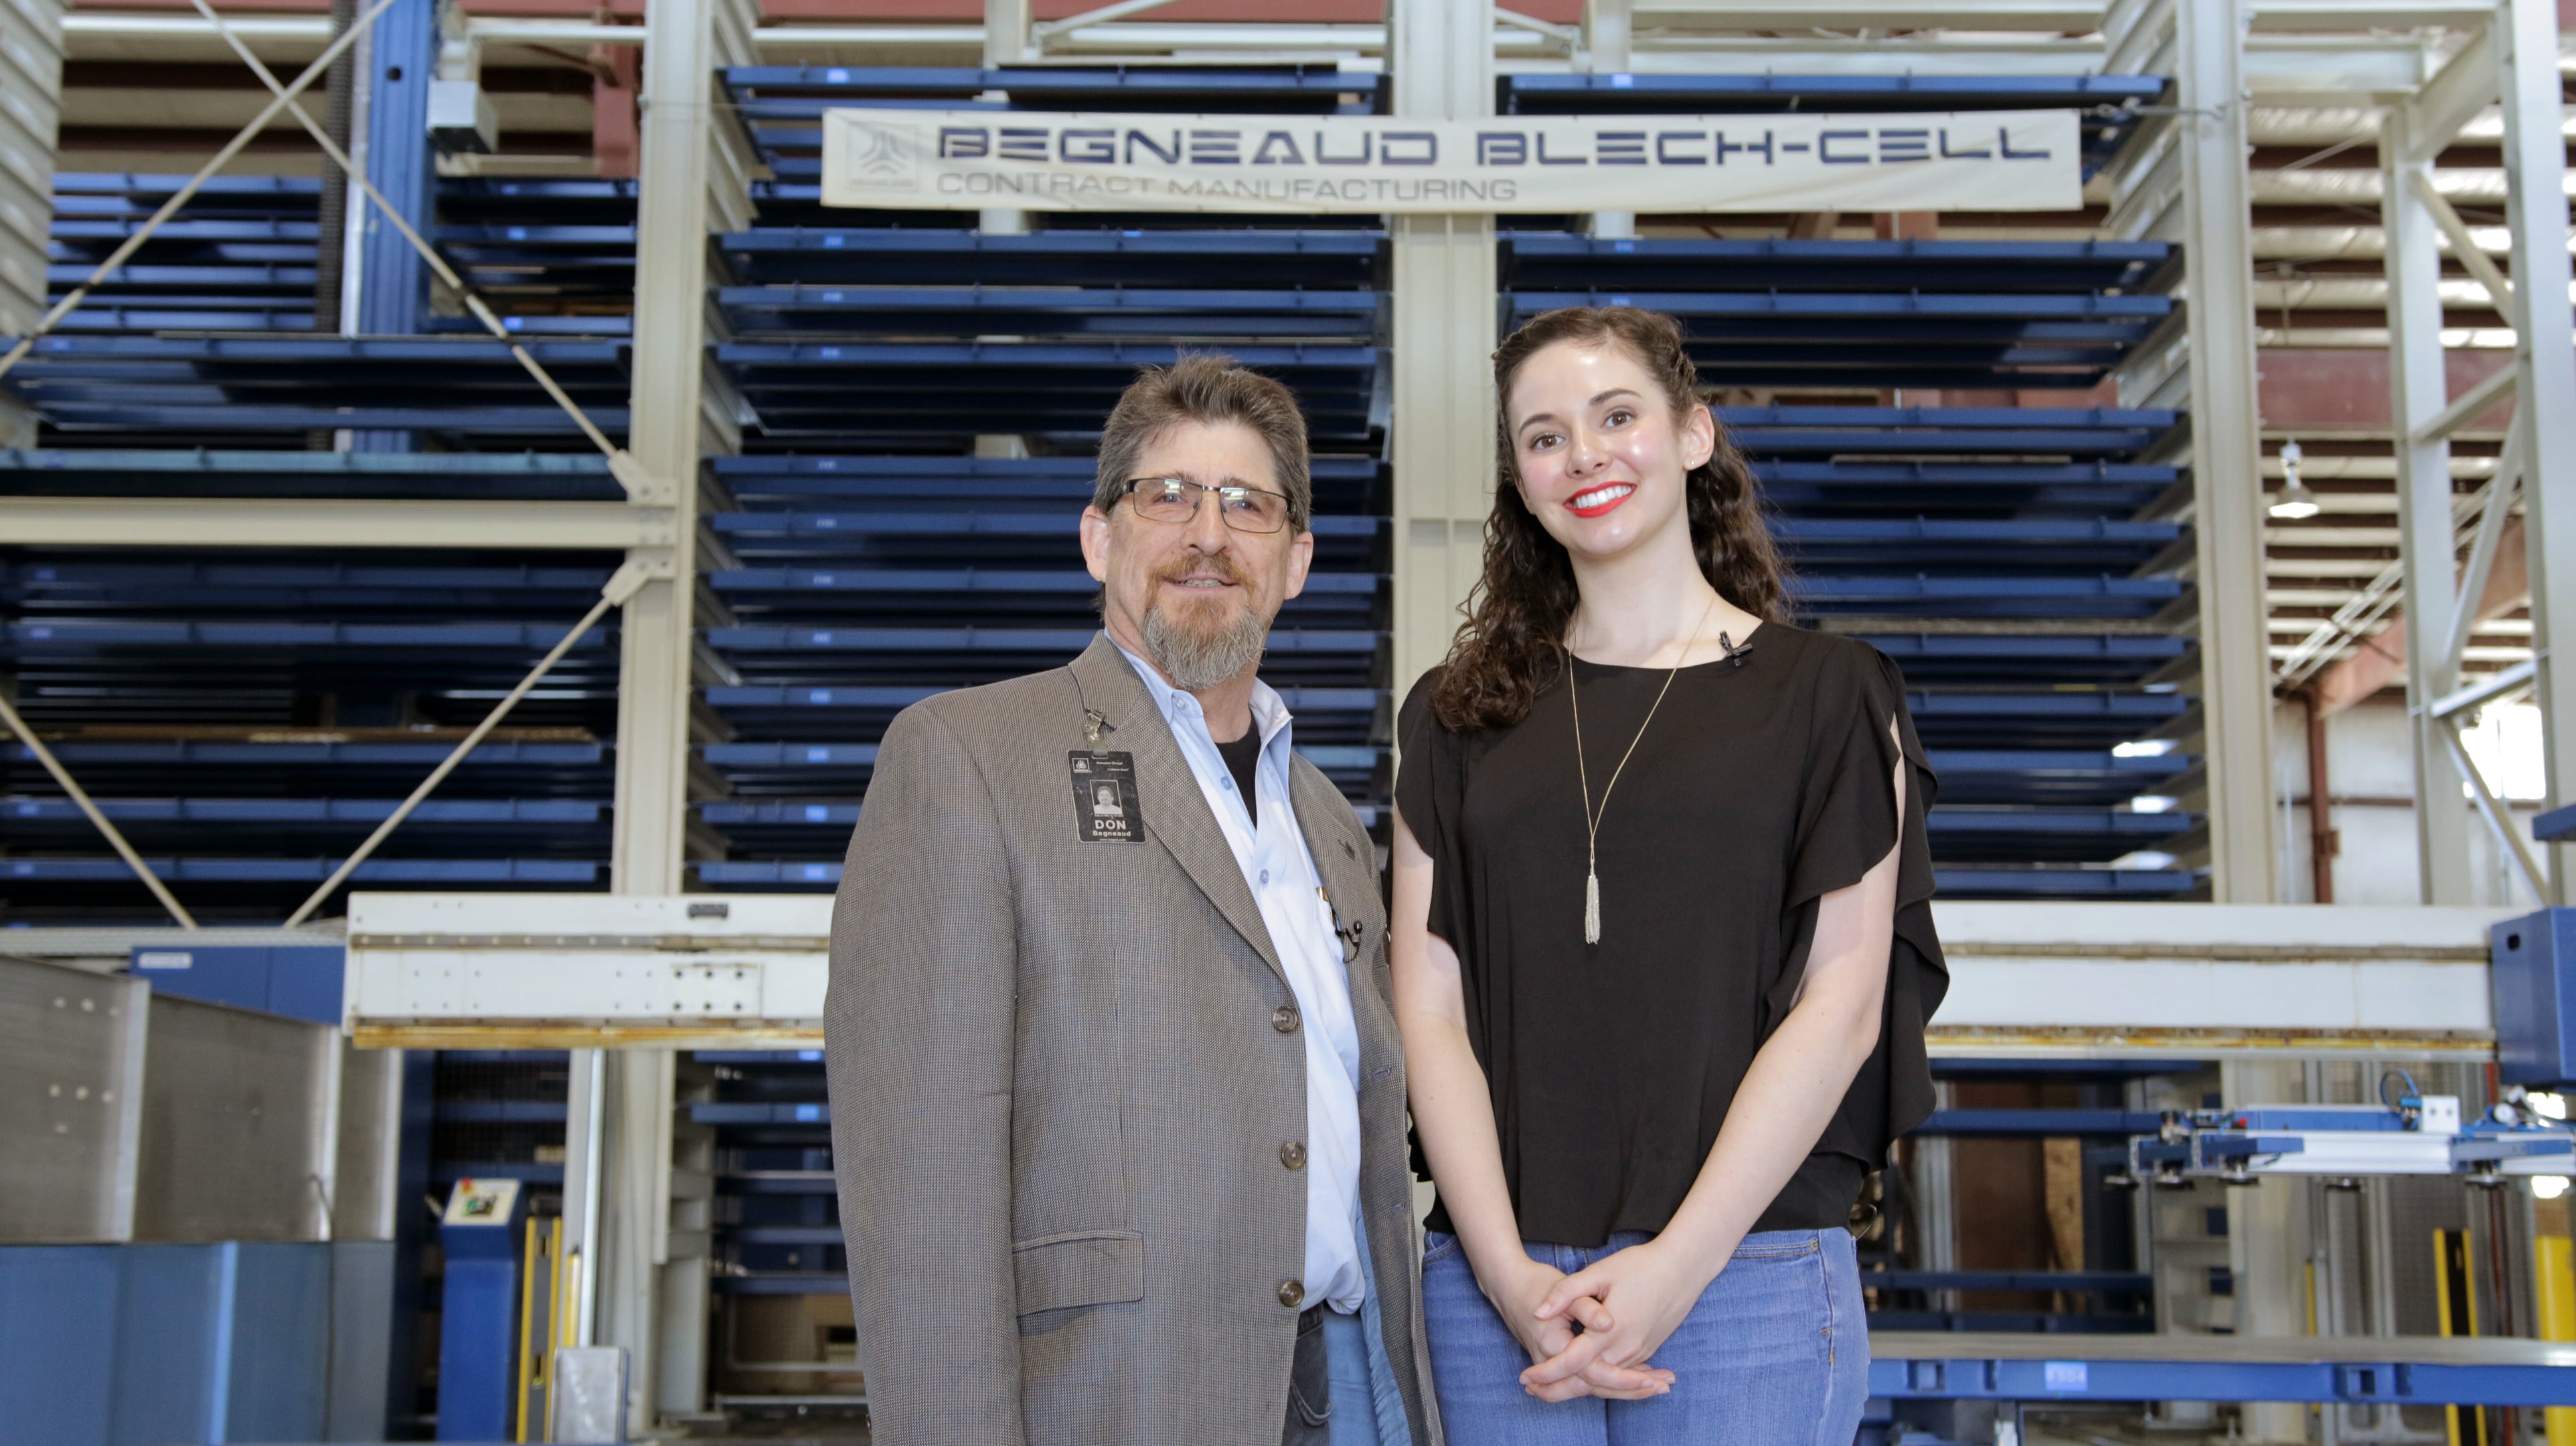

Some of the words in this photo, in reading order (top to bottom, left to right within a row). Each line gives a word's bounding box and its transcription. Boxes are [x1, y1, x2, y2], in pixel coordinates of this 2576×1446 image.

[937, 127, 1439, 166] BEGNEAUD
[1476, 127, 2051, 166] BLECH-CELL
[937, 171, 1154, 195] CONTRACT
[1168, 175, 1518, 202] MANUFACTURING
[1095, 819, 1127, 830] DON
